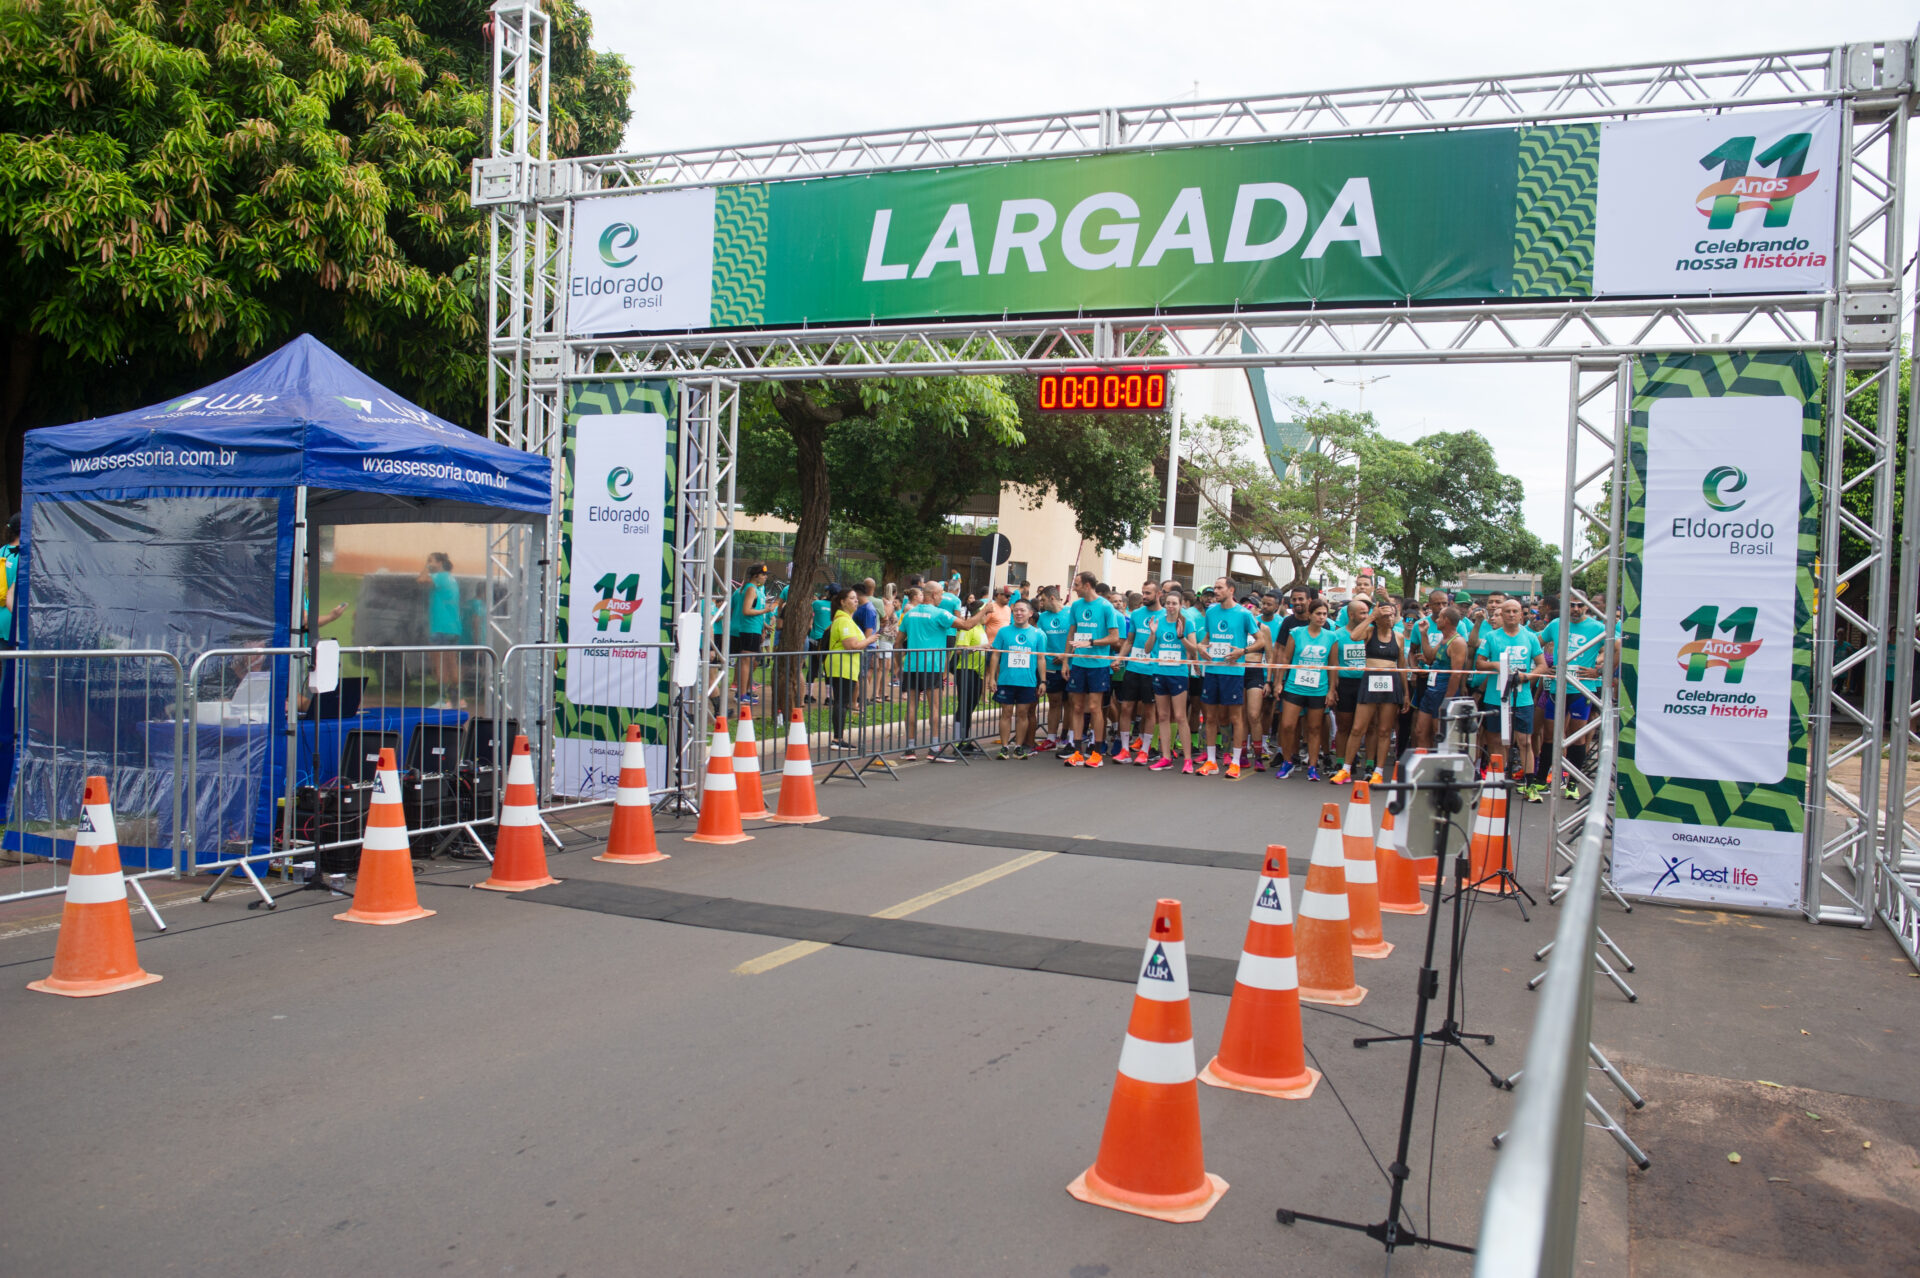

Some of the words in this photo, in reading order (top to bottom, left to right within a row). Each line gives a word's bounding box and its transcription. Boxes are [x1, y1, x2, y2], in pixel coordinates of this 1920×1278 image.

[1730, 178, 1789, 195] Anos
[862, 176, 1382, 282] LARGADA
[1694, 236, 1809, 254] Celebrando
[1676, 257, 1738, 271] nossa
[1743, 252, 1826, 269] história
[572, 272, 664, 297] Eldorado
[623, 294, 662, 309] Brasil
[1041, 375, 1164, 409] 00:00:00
[70, 446, 238, 473] wxassessoria.com.br
[362, 456, 510, 489] wxassessoria.com.br
[589, 506, 650, 522] Eldorado
[623, 523, 649, 534] Brasil
[1672, 517, 1774, 539] Eldorado
[1729, 541, 1773, 555] Brasil
[606, 600, 631, 610] Anos
[584, 647, 609, 657] nossa
[1701, 640, 1742, 655] Anos
[1013, 658, 1026, 666] 570
[1300, 676, 1315, 685] 545
[1373, 681, 1388, 690] 698
[1676, 689, 1756, 705] Celebrando
[1663, 703, 1707, 715] nossa
[1710, 703, 1768, 719] história
[1672, 832, 1741, 847] ORGANIZAÇÃO
[1690, 863, 1729, 884] best
[1733, 868, 1758, 886] life
